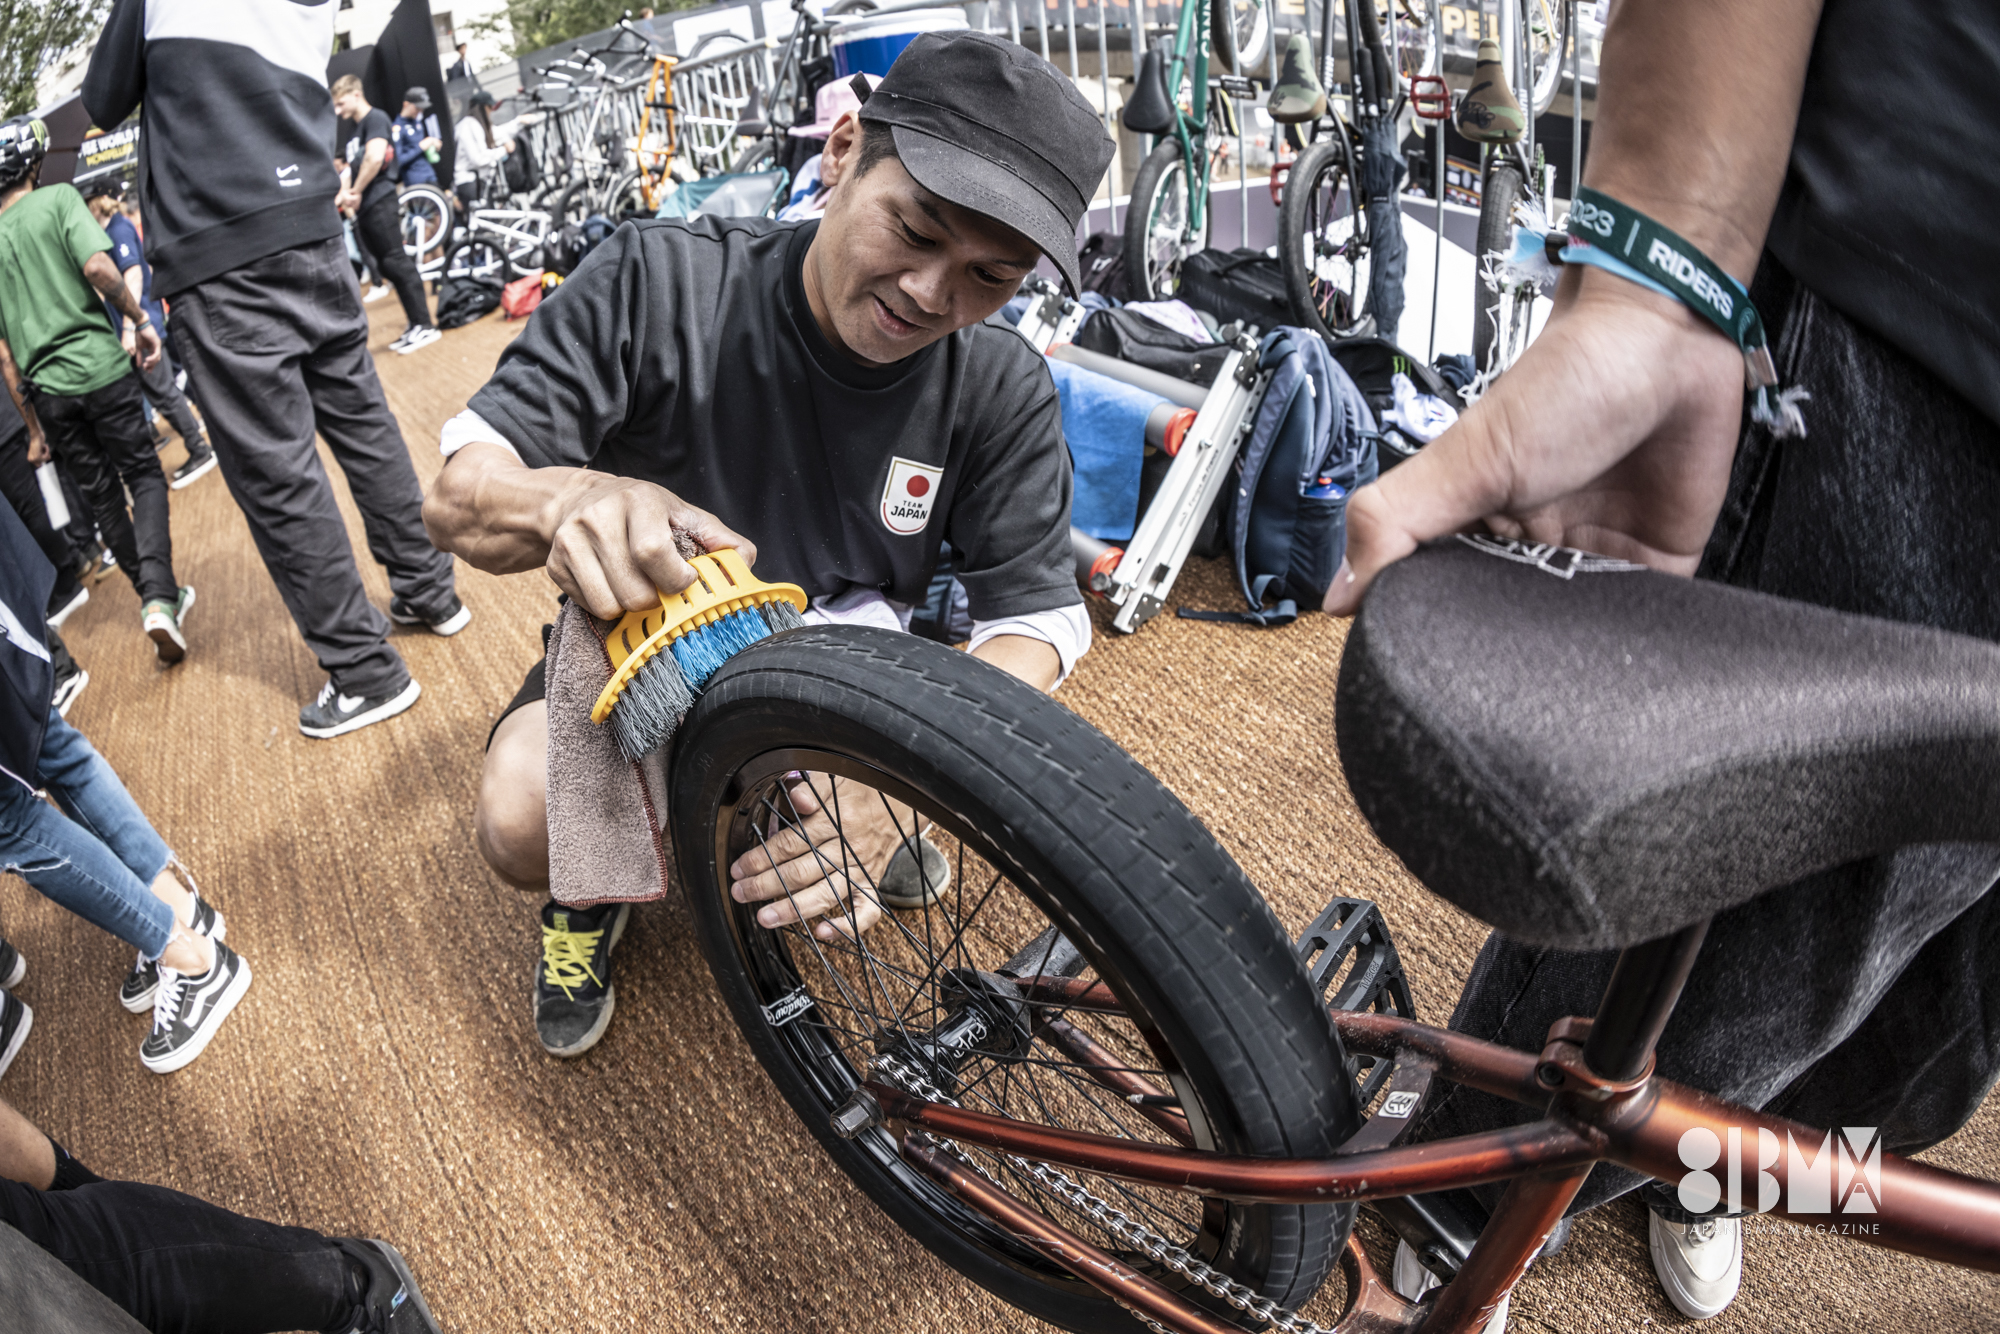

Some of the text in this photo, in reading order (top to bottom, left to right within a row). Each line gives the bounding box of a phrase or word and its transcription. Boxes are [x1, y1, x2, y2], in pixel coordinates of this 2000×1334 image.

[1647, 237, 1734, 320] RIDERS
[903, 500, 923, 509] TEAM
[890, 505, 928, 520] JAPAN
